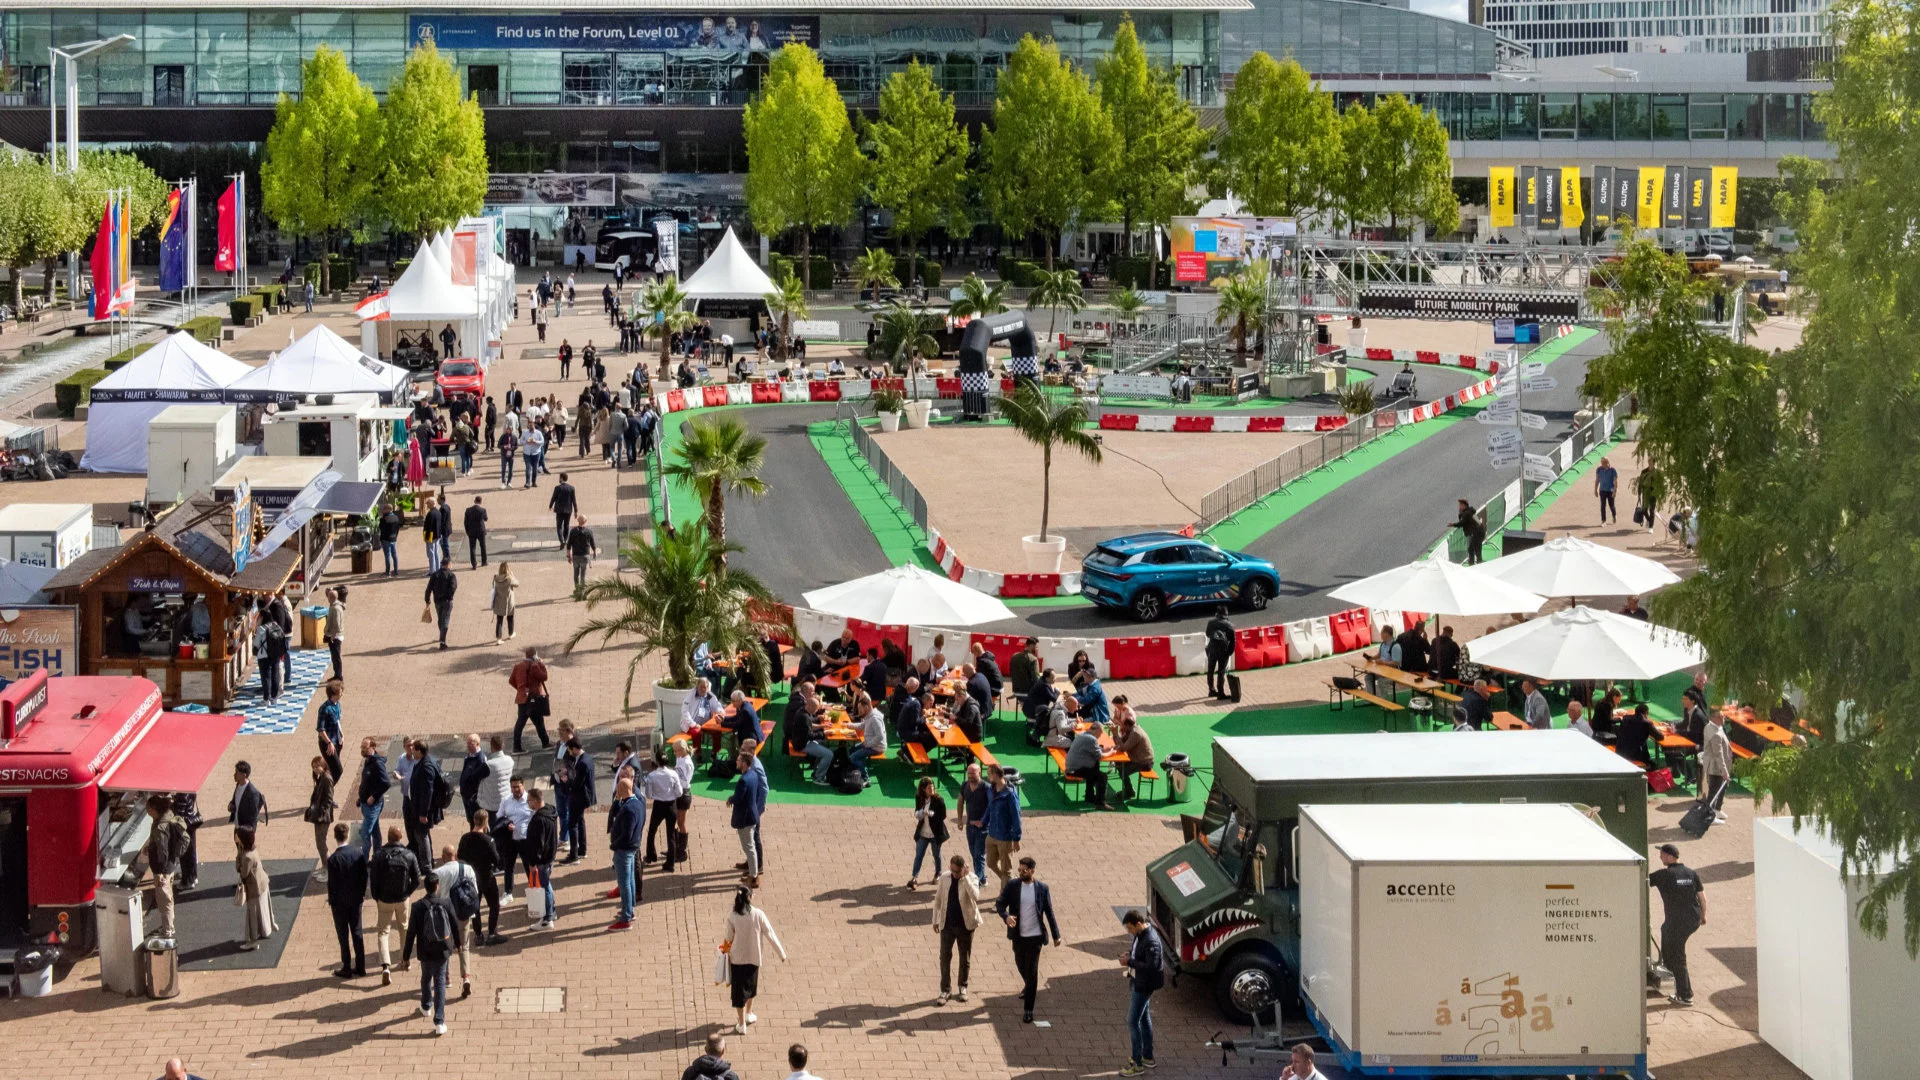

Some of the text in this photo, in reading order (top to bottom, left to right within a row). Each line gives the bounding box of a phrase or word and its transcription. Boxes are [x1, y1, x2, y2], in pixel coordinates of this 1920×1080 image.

[497, 26, 679, 40] Find us in the Forum, Level 01
[1566, 178, 1575, 206] MAPA
[1600, 178, 1608, 204] CLUTCH
[1621, 180, 1629, 207] CLUTCH
[1645, 179, 1655, 206] MAPA
[1672, 172, 1681, 208] KUPPLUNG
[1720, 178, 1728, 205] MAPA
[1415, 299, 1520, 312] FUTURE MOBILITY PARK
[124, 391, 147, 399] FALAFEL
[155, 389, 189, 400] SHAWARMA
[133, 578, 180, 590] Fish & Chips
[22, 627, 60, 644] Fresh
[15, 686, 46, 726] CURRYWURST
[0, 768, 68, 780] STSNACKS
[1386, 882, 1456, 896] accente
[1545, 896, 1580, 906] perfect
[1545, 910, 1613, 919] INGREDIENTS,
[1545, 920, 1580, 932] perfect
[1545, 934, 1597, 943] MOMENTS.
